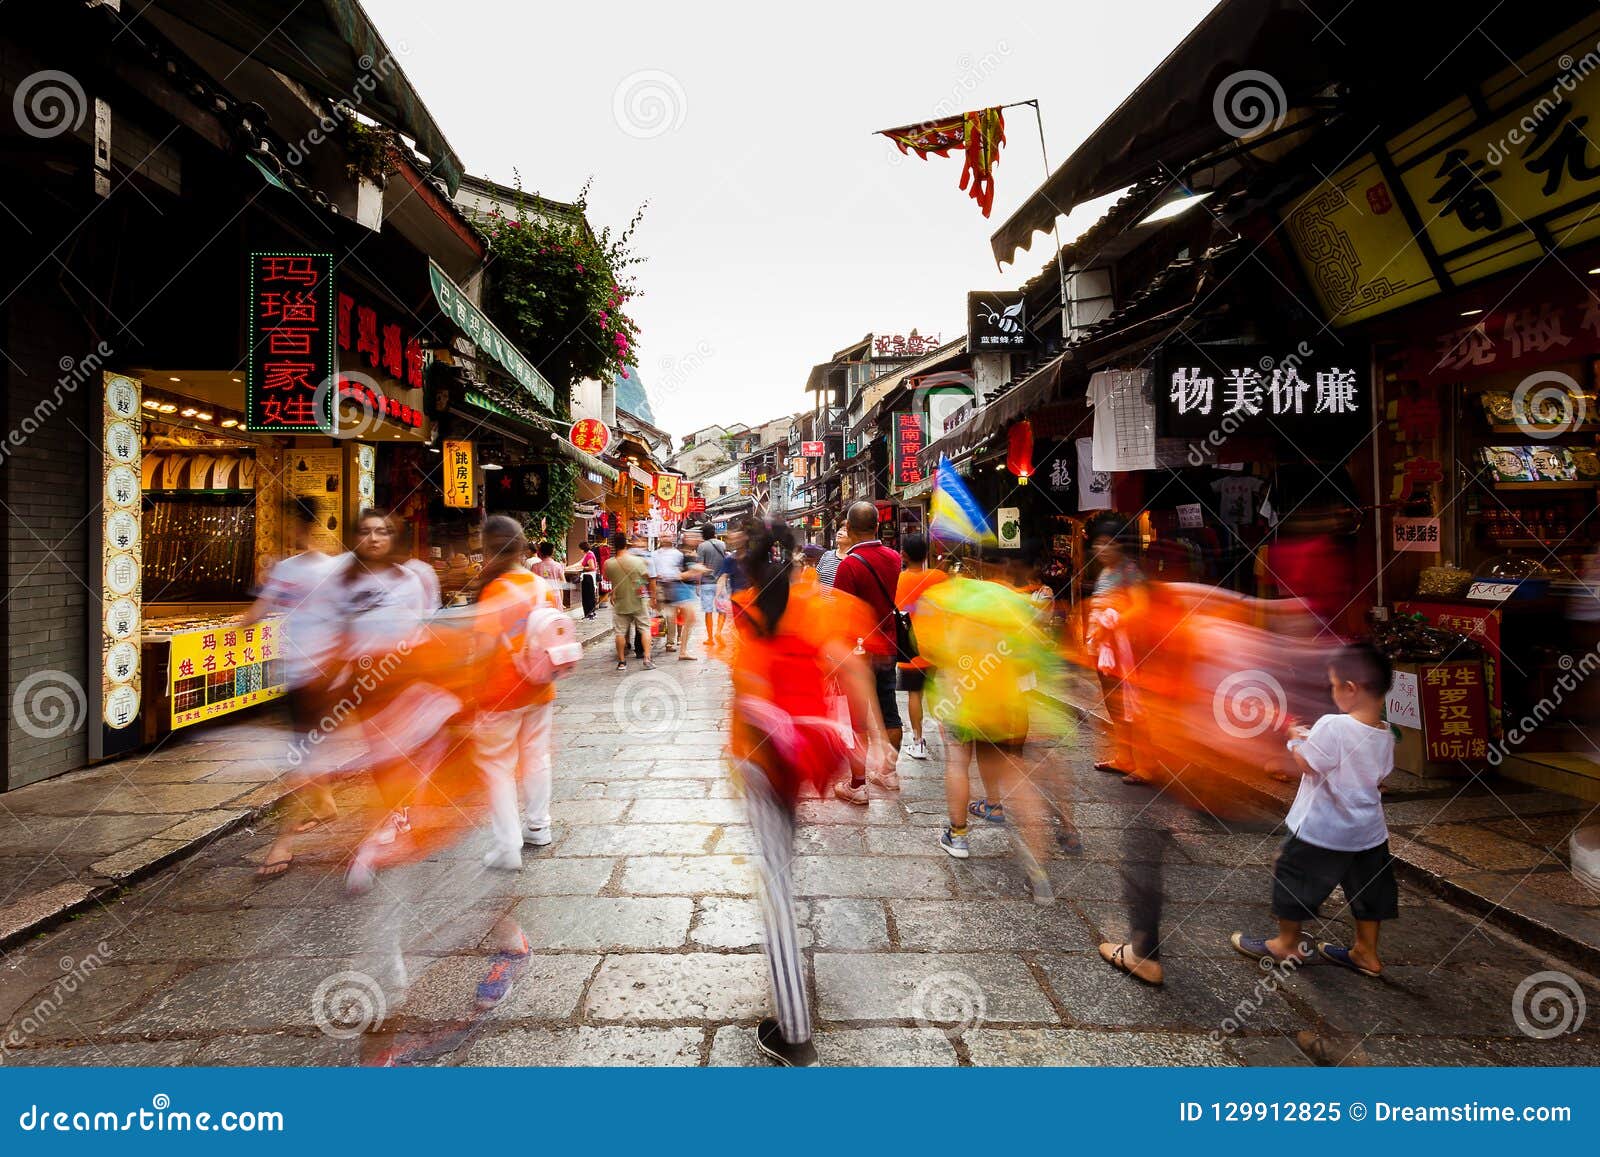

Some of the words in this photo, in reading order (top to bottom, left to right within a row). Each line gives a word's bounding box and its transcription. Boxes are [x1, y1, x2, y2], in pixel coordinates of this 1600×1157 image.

[260, 257, 318, 425] 玛瑙百家姓
[1169, 367, 1360, 416] 物美价廉
[900, 413, 921, 483] 越南商品馆
[455, 451, 469, 494] 跳房子
[1395, 524, 1438, 542] 快递服务
[1425, 667, 1479, 686] 野生
[1438, 688, 1474, 736] 罗汉果
[1431, 737, 1487, 759] 10元/袋
